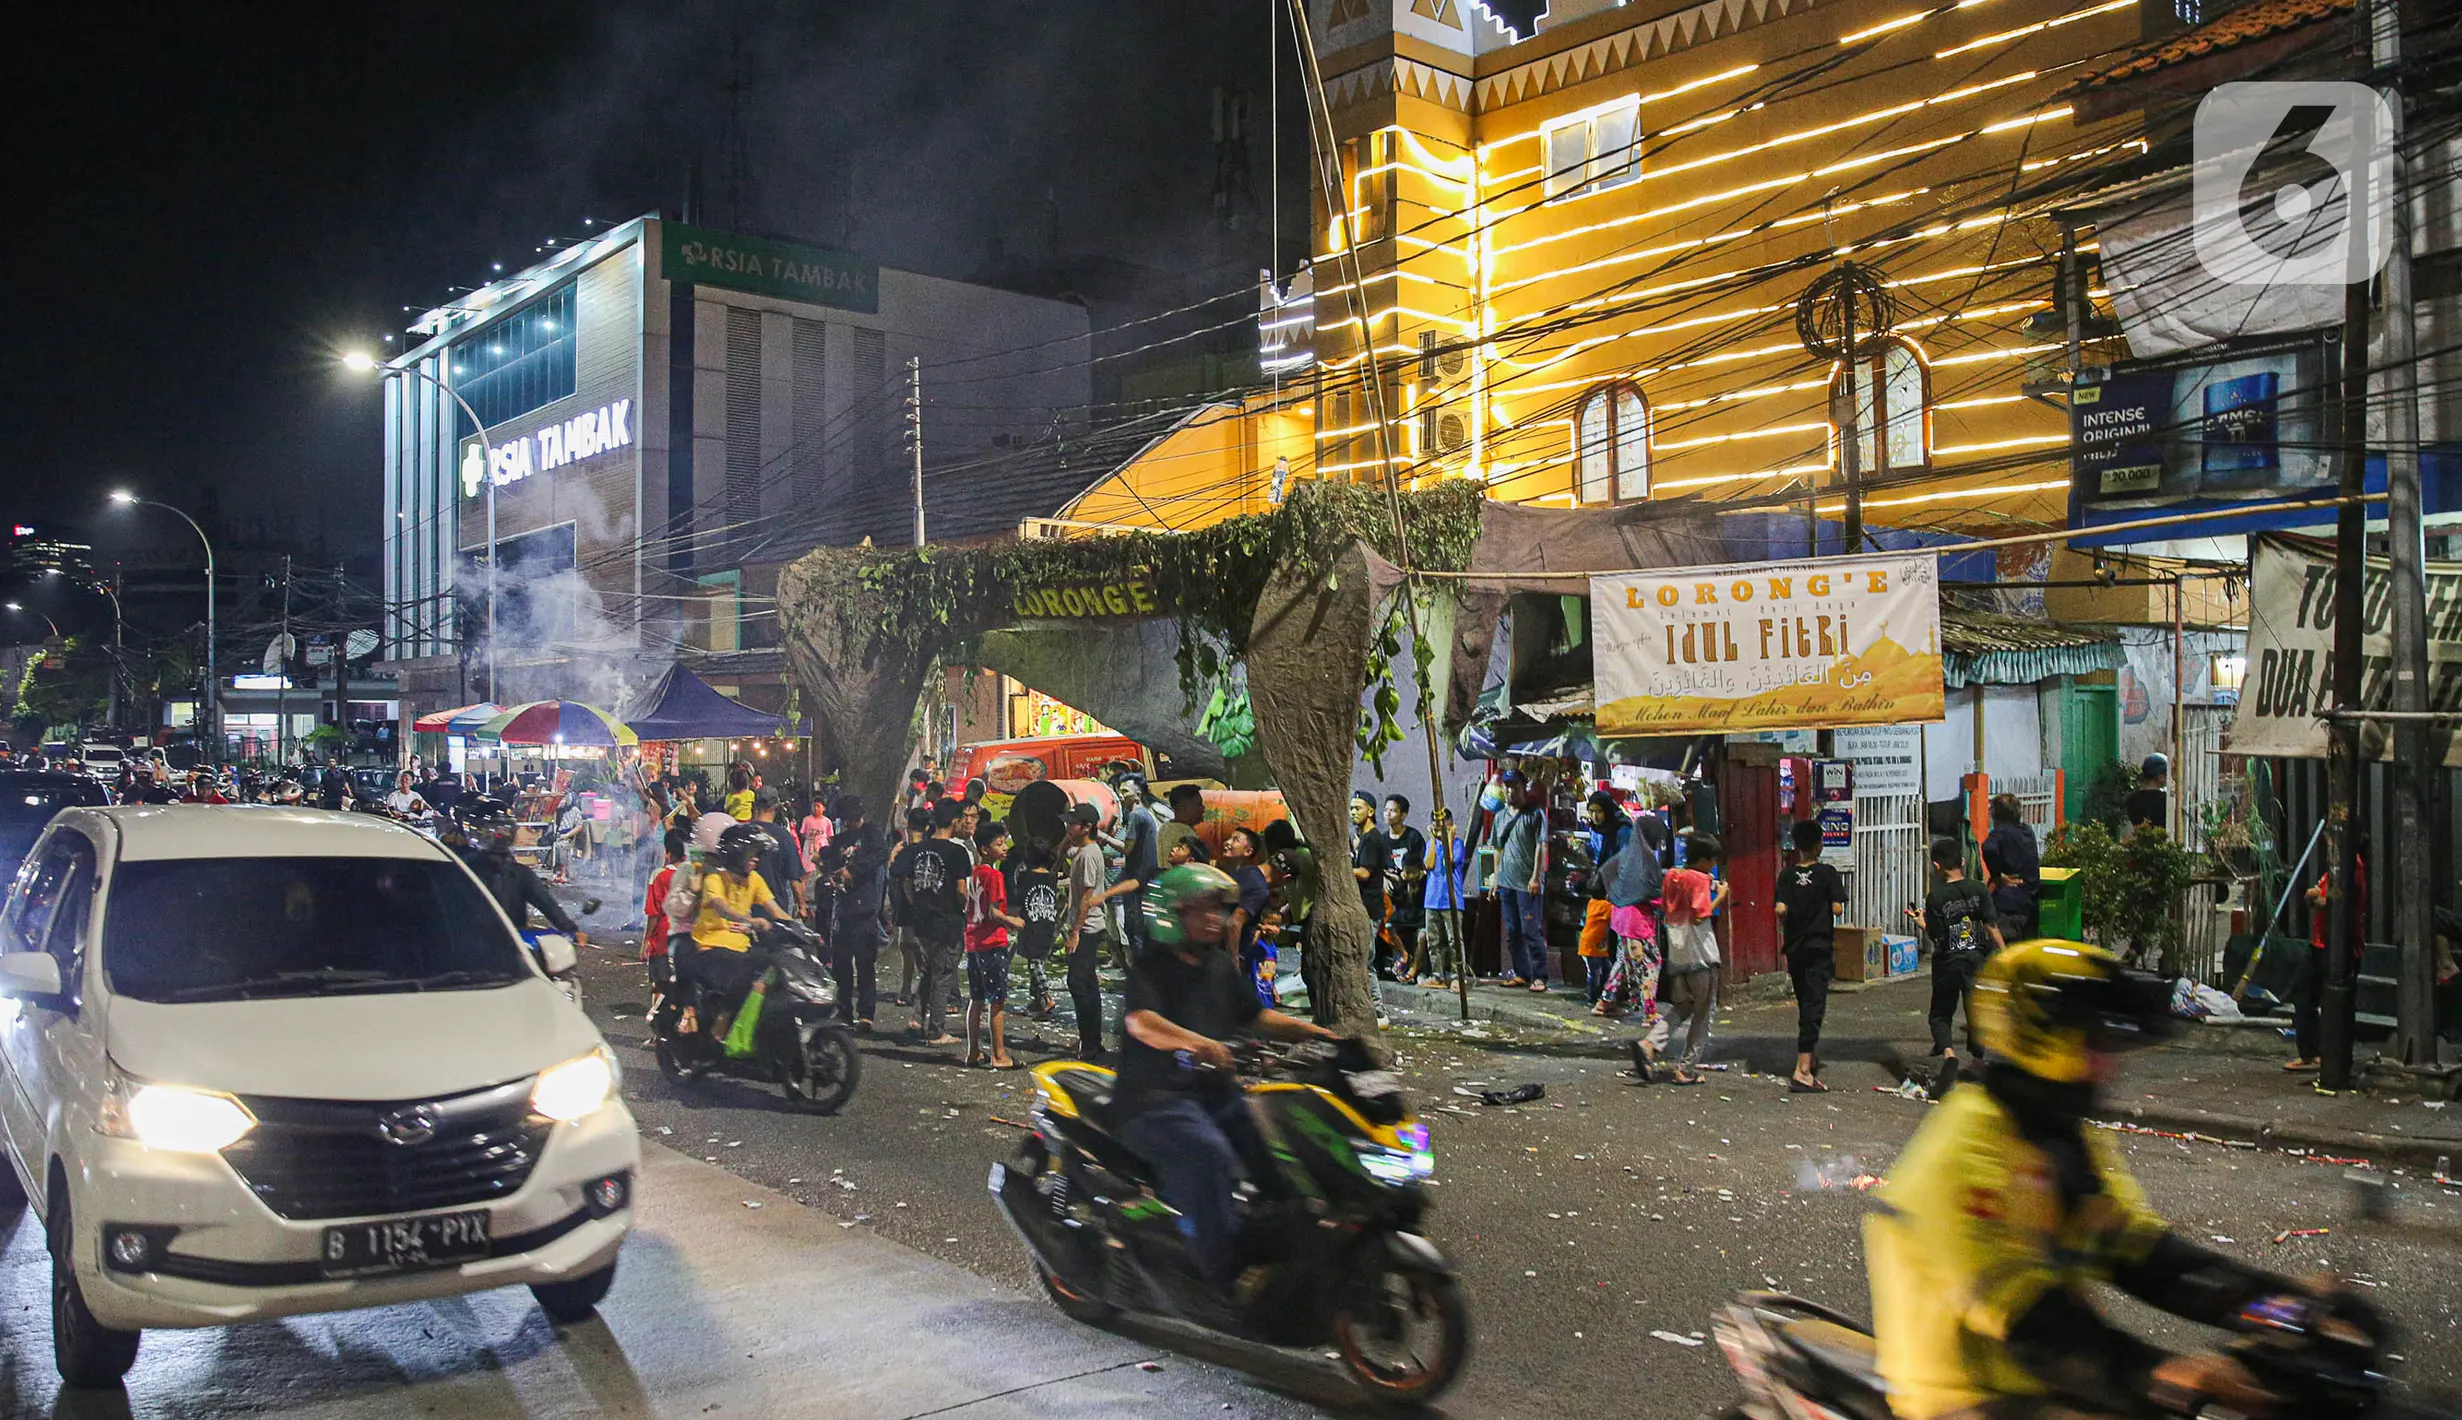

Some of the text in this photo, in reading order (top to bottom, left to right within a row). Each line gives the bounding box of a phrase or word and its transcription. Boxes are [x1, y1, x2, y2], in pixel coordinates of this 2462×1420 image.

[709, 248, 868, 293] RSIA TAMBAK
[2078, 391, 2096, 401] NEW
[2083, 406, 2146, 428] INTENSE
[490, 398, 633, 487] RSIA TAMBAK
[2112, 468, 2150, 482] 20.000
[1626, 571, 1889, 609] LORONG'E
[2256, 649, 2315, 718] DUA
[1630, 693, 1895, 725] Mohon Maaf Lahir dan Bathin
[328, 1230, 346, 1261] B
